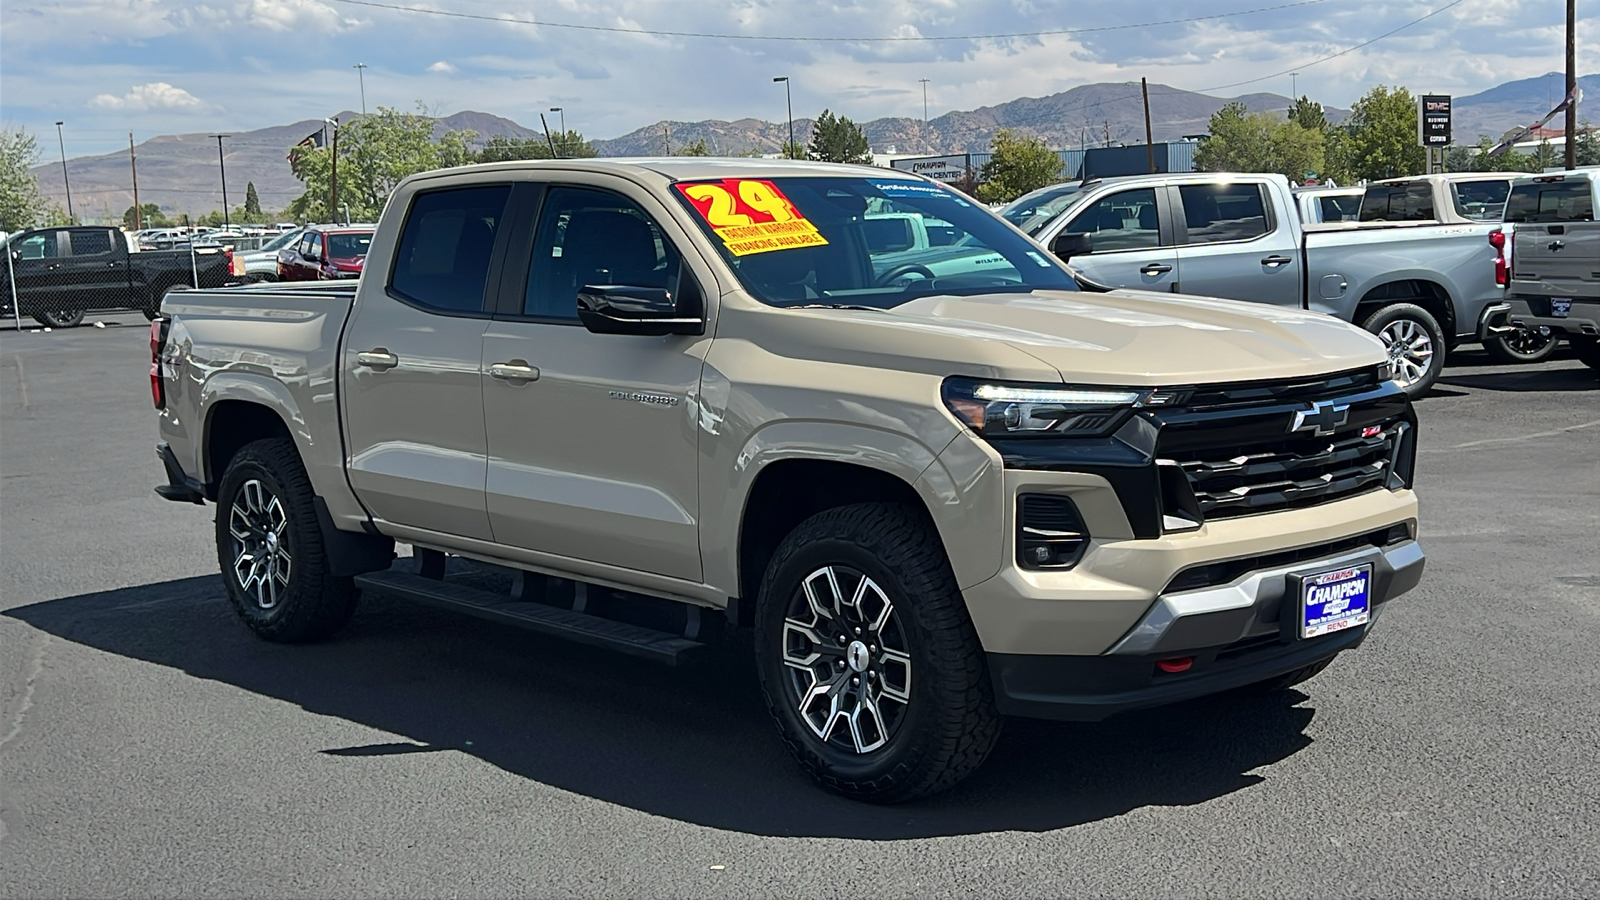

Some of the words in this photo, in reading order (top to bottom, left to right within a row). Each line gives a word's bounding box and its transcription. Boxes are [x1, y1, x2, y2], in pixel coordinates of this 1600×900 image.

[1427, 102, 1449, 110] GMC
[912, 161, 947, 173] CHAMPION
[933, 170, 962, 179] CENTER
[684, 180, 797, 226] 24
[721, 225, 765, 240] FACTORY
[761, 220, 811, 235] WARRANTY
[729, 238, 778, 253] FINANCING
[777, 233, 822, 247] AVAILABLE
[608, 390, 679, 406] COLORADO
[1322, 570, 1354, 583] CHAMPION
[1306, 578, 1365, 606] CHAMPION
[1327, 620, 1348, 631] RENO
